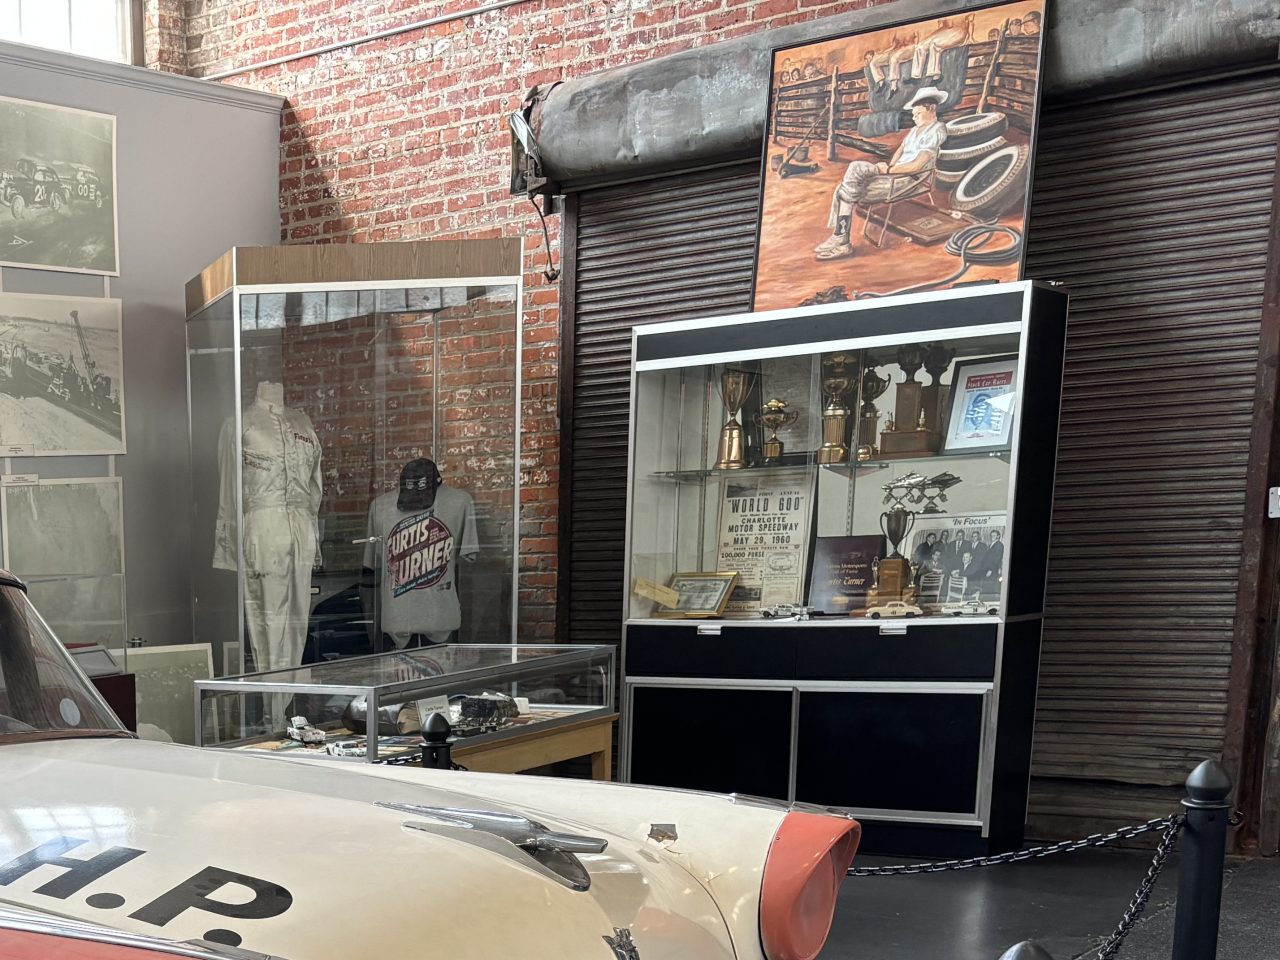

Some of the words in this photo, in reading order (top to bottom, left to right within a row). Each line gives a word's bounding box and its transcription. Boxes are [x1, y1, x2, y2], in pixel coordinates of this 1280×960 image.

[387, 519, 430, 558] CURTIS
[728, 525, 753, 533] MOTOR
[758, 523, 799, 531] SPEEDWAY
[733, 537, 749, 545] MAY
[754, 536, 767, 545] 29,
[772, 535, 791, 544] 1960
[390, 537, 454, 589] TURNER
